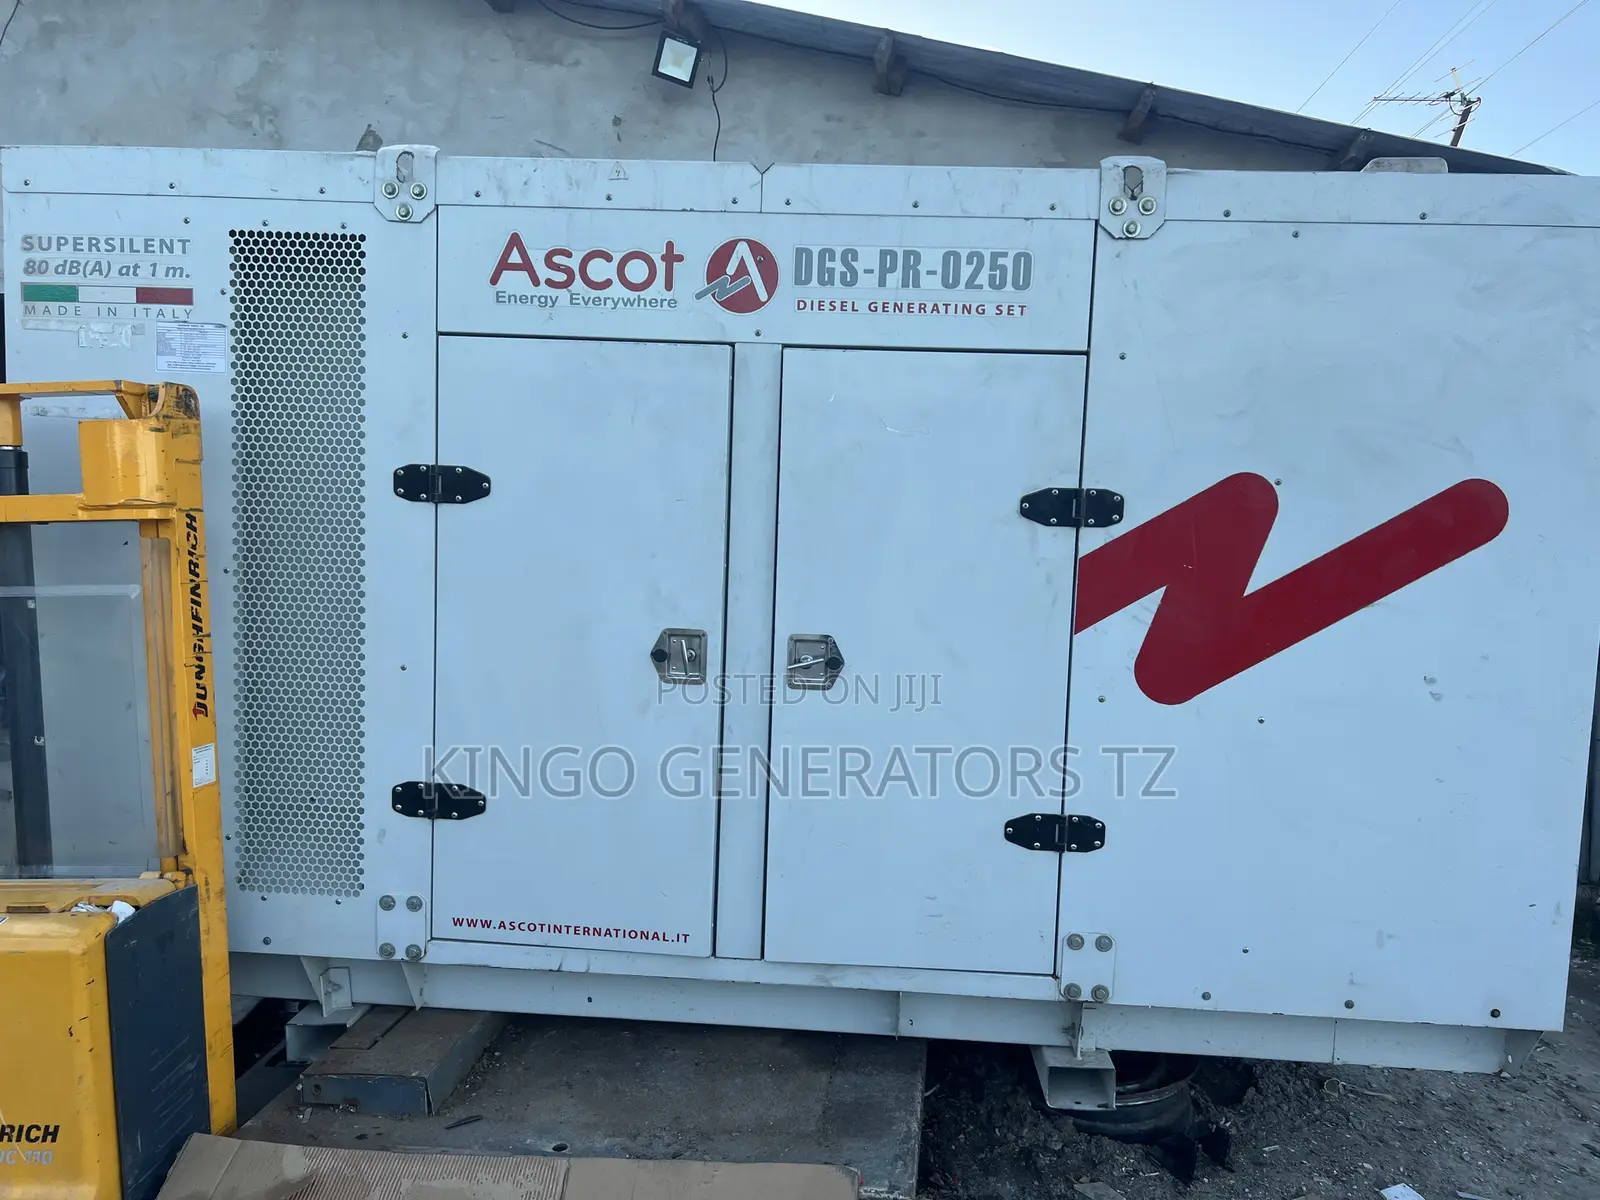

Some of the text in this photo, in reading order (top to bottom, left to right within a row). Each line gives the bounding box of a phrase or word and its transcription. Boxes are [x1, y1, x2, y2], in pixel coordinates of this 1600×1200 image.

[22, 235, 191, 255] SUPERSILENT
[23, 259, 191, 279] 80 dB(A) at 1 m.
[489, 232, 685, 292] Ascot
[793, 246, 1033, 291] DGS-PR-0250
[495, 290, 678, 310] Energy Everywhere
[796, 299, 1027, 317] DIESEL GENERATING SET
[24, 304, 193, 320] MADE IN ITALY
[452, 917, 690, 943] WWW.ASCOTINTERNATIONAL.IT
